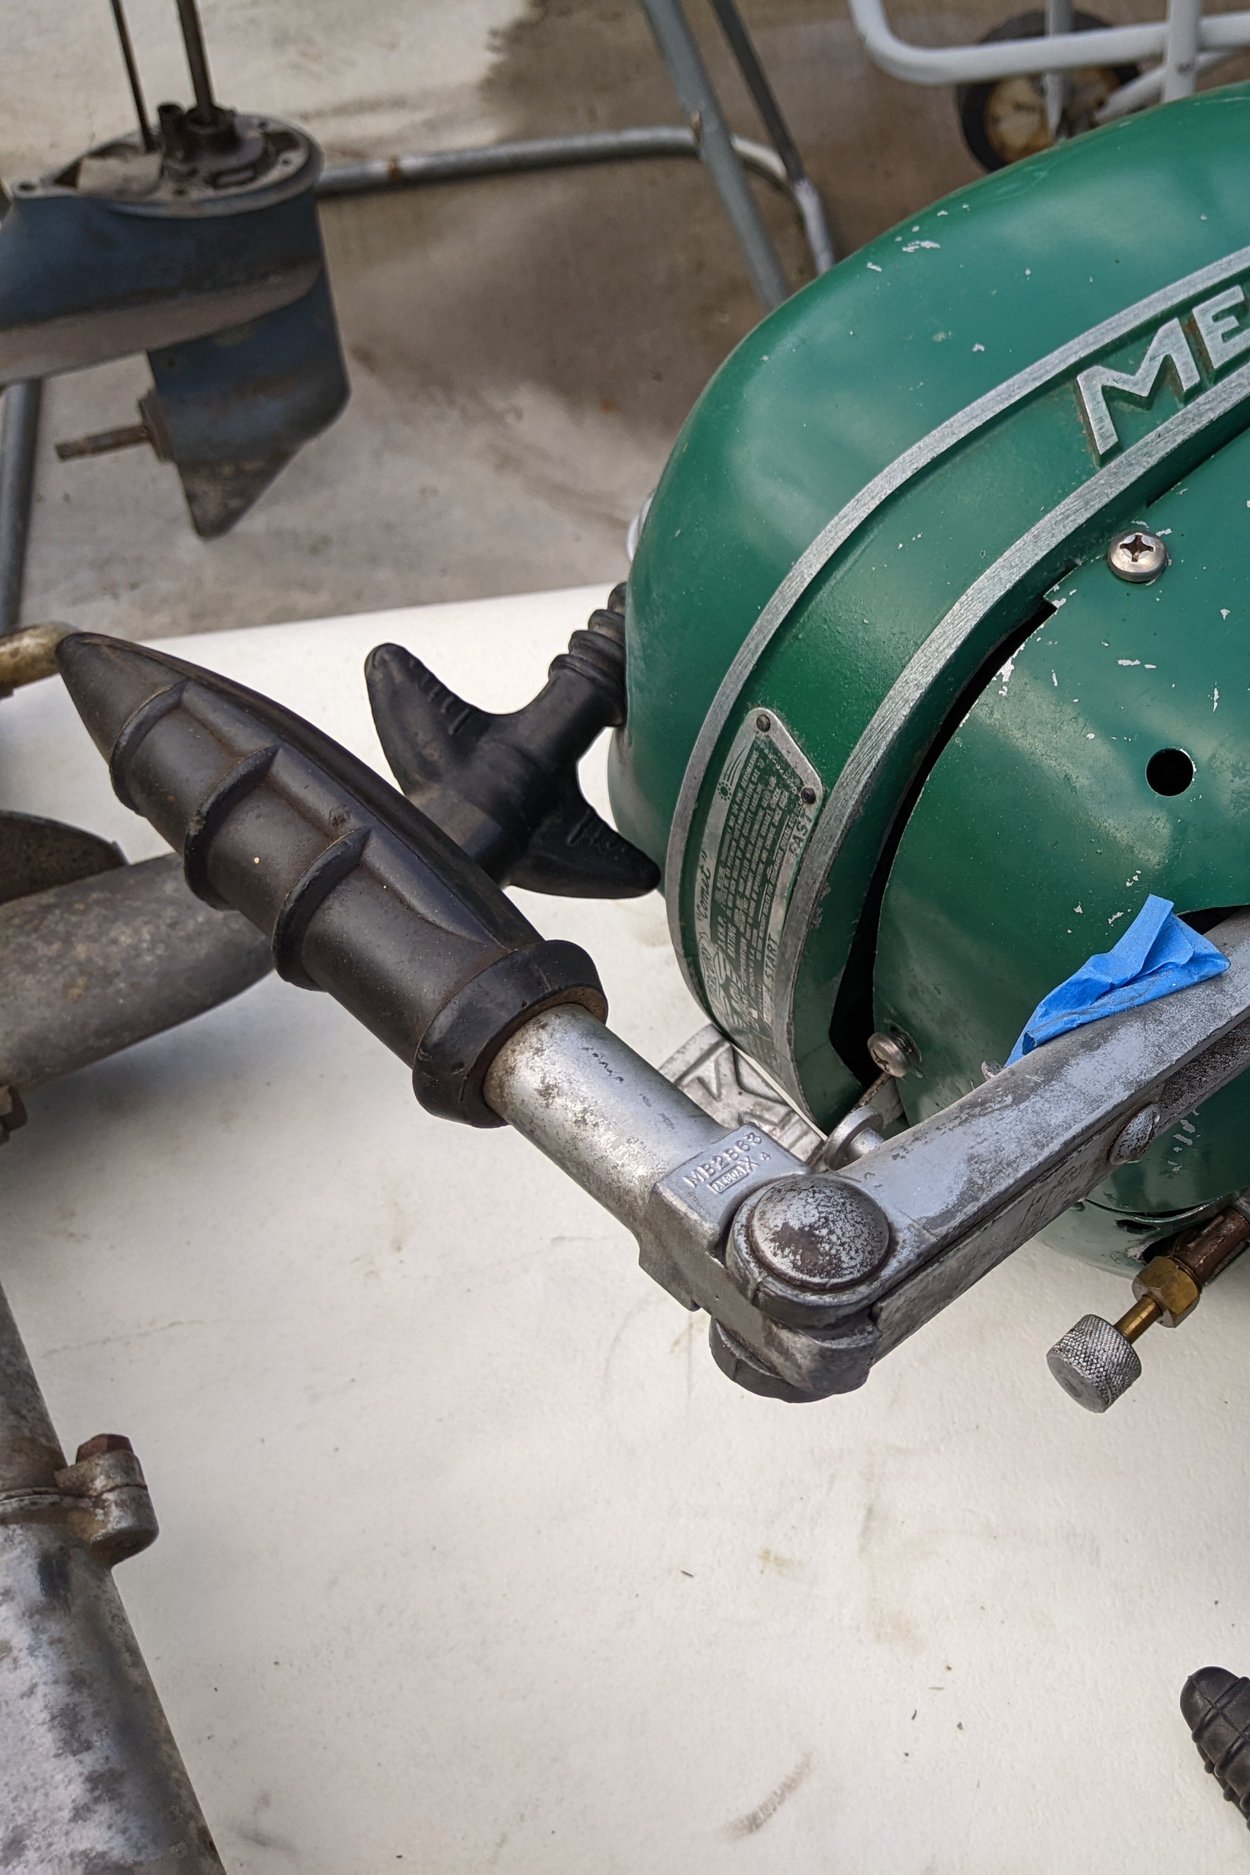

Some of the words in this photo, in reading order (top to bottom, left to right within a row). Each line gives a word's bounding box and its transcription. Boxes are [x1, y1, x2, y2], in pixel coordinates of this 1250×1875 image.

[787, 806, 813, 857] FAST
[695, 850, 710, 919] "Comet"
[727, 922, 736, 959] RATING
[763, 933, 778, 980] START
